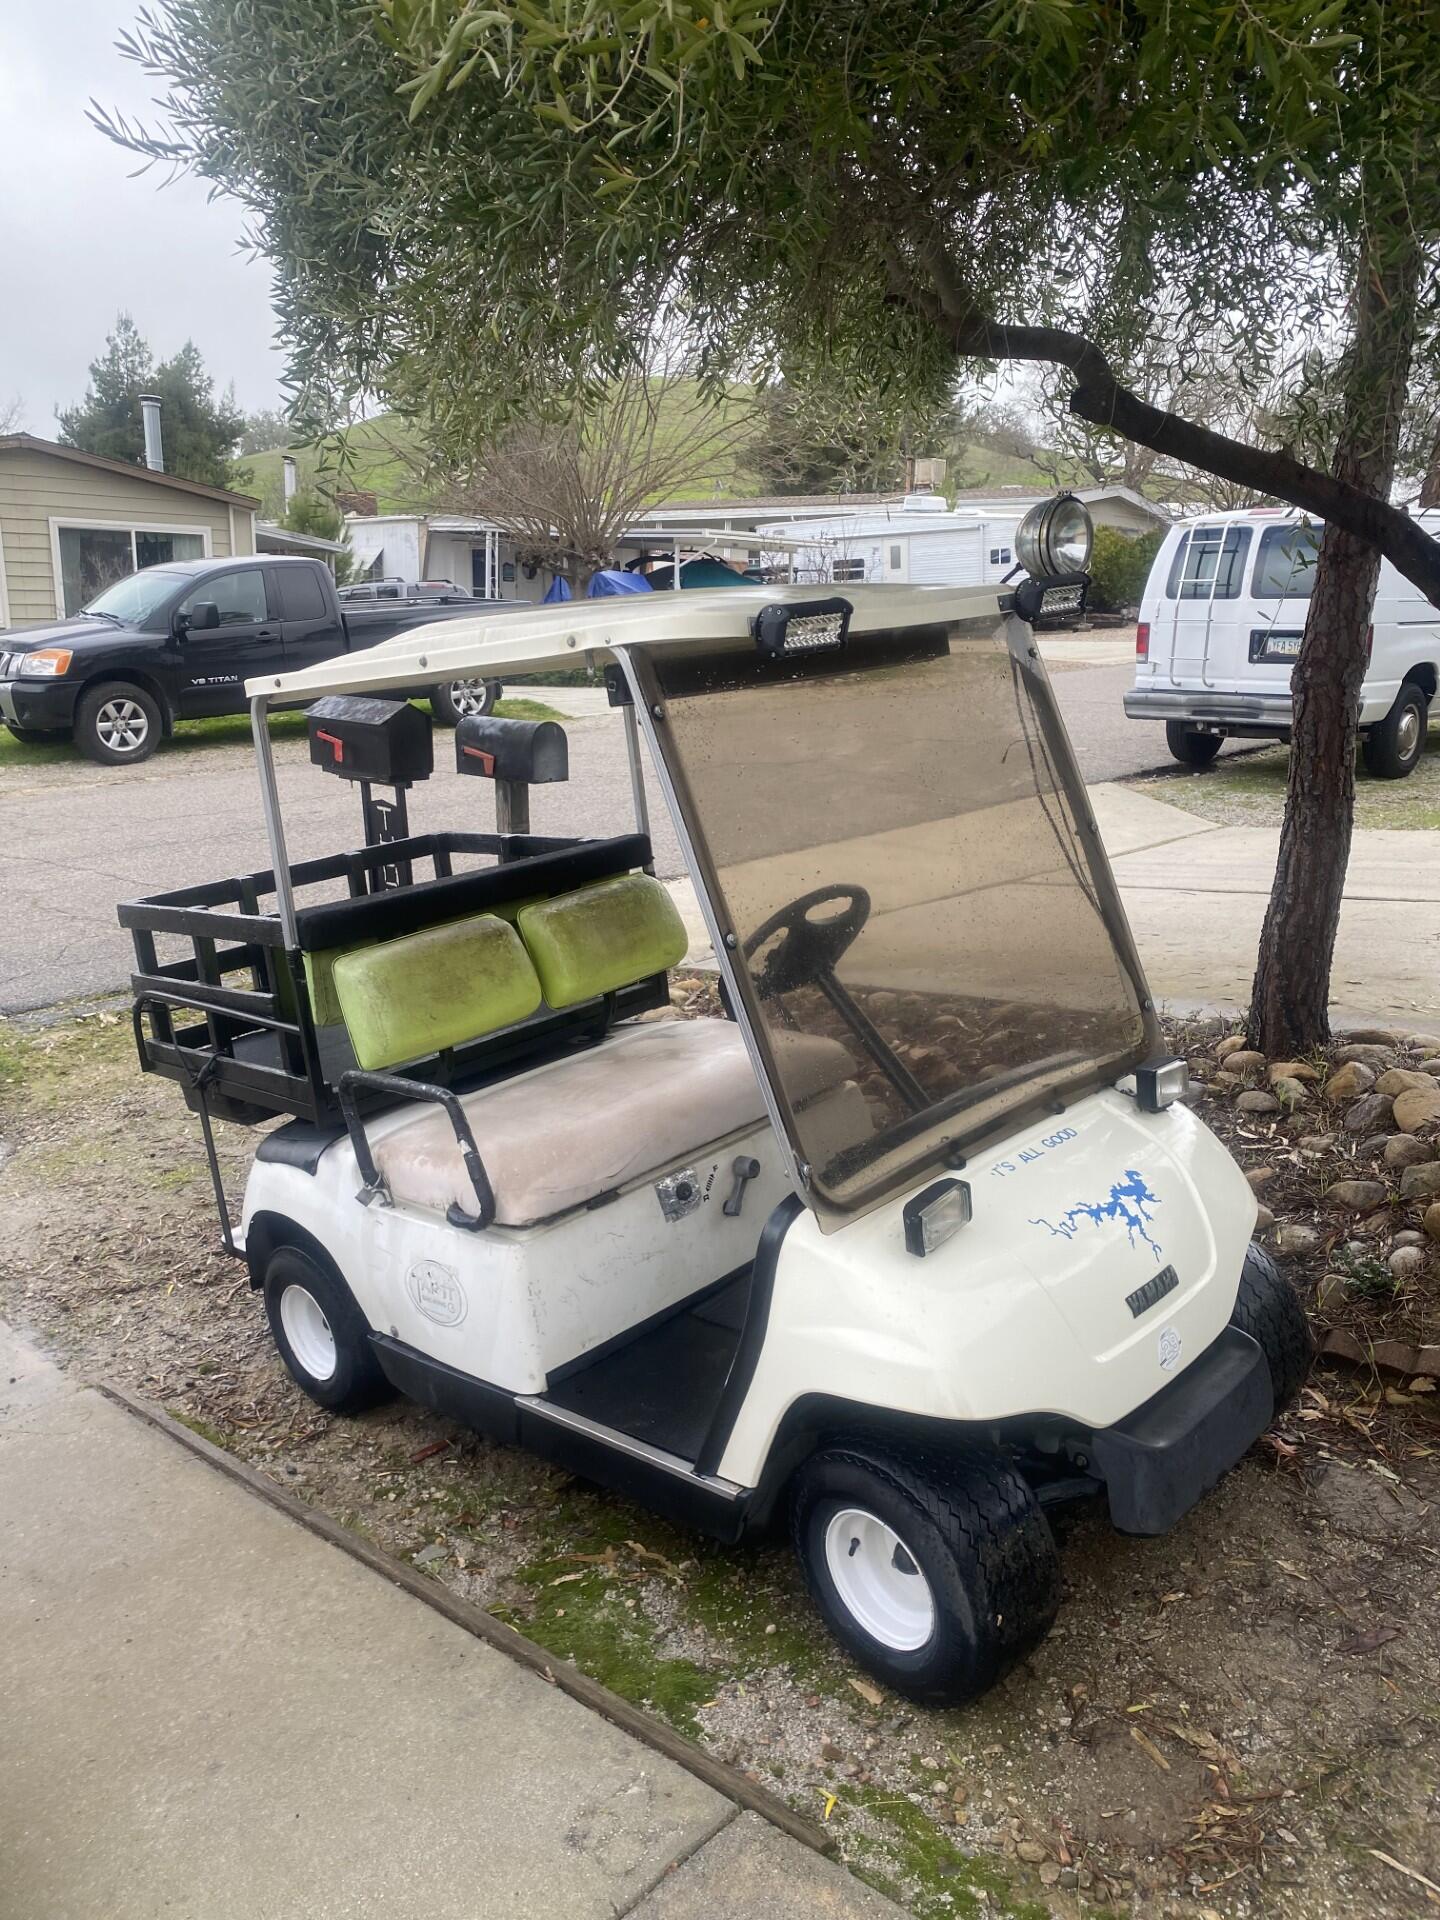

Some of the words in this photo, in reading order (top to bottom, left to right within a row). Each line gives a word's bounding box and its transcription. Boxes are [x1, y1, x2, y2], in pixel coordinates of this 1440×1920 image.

[207, 675, 238, 684] TITAN
[1017, 1147, 1045, 1164] ALL
[1041, 1127, 1078, 1149] GOOD
